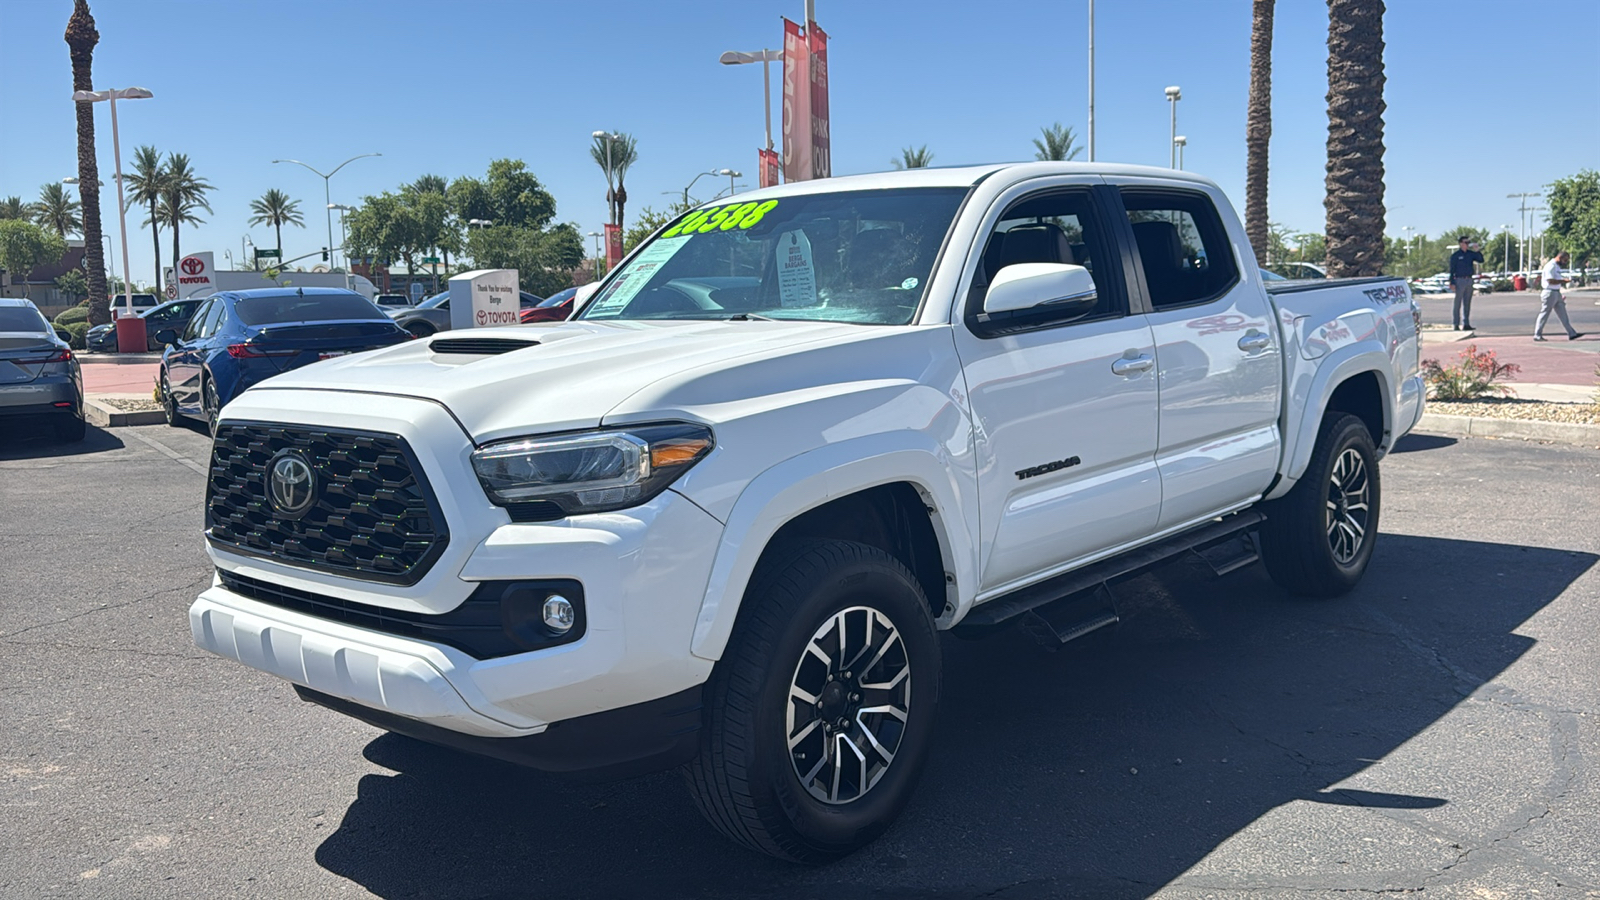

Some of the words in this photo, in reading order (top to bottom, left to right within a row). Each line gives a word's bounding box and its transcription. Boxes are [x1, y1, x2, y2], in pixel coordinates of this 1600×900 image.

[783, 31, 796, 182] COME
[661, 199, 779, 238] 26588
[784, 260, 807, 269] BARGAINS
[179, 276, 210, 284] TOYOTA
[489, 295, 502, 306] Berge
[487, 311, 517, 323] TOYOTA
[1015, 455, 1081, 480] TACOMA
